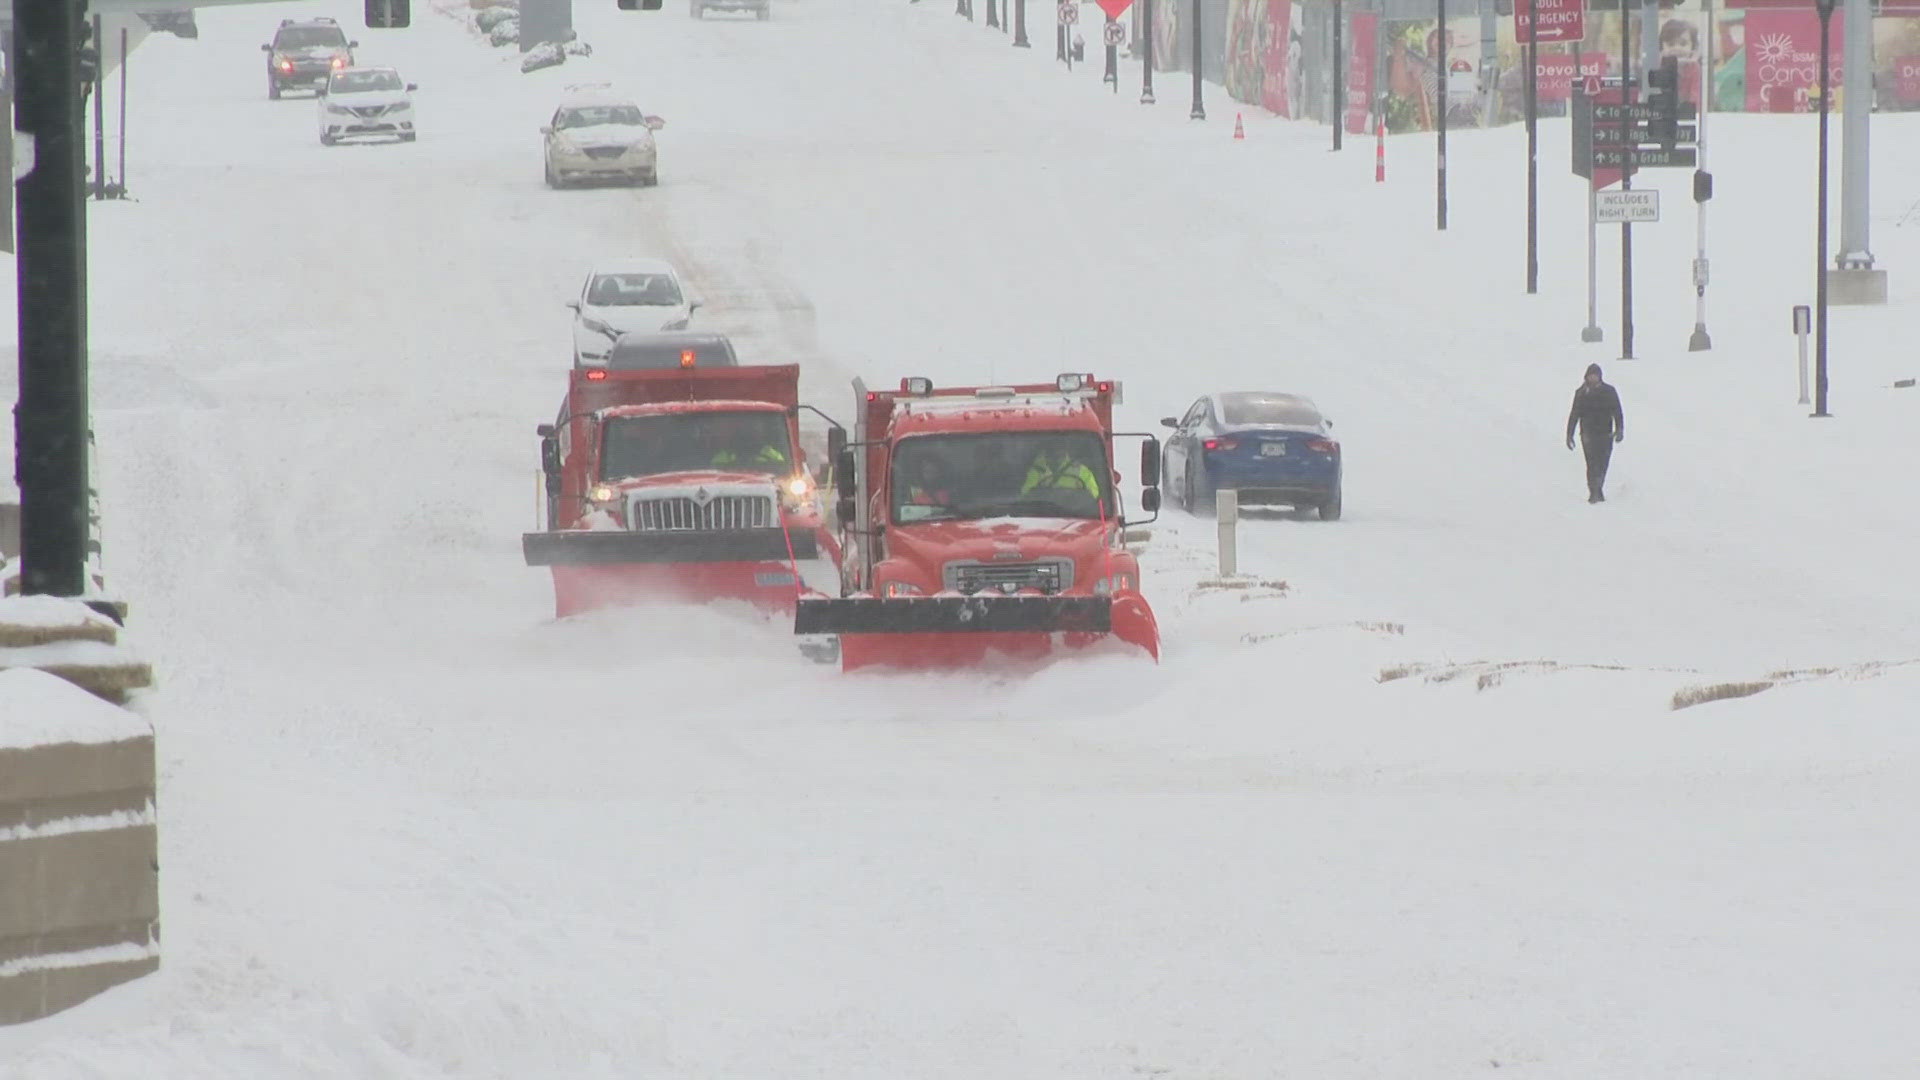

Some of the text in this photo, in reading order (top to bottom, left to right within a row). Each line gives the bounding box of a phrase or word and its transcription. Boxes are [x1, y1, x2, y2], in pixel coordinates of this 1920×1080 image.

[1518, 12, 1579, 26] EMRGENCY
[1609, 106, 1619, 117] To
[1609, 130, 1620, 141] To
[1641, 152, 1670, 163] Grand
[1604, 194, 1649, 204] INCLUDES
[1599, 207, 1655, 218] RIGHT TURN
